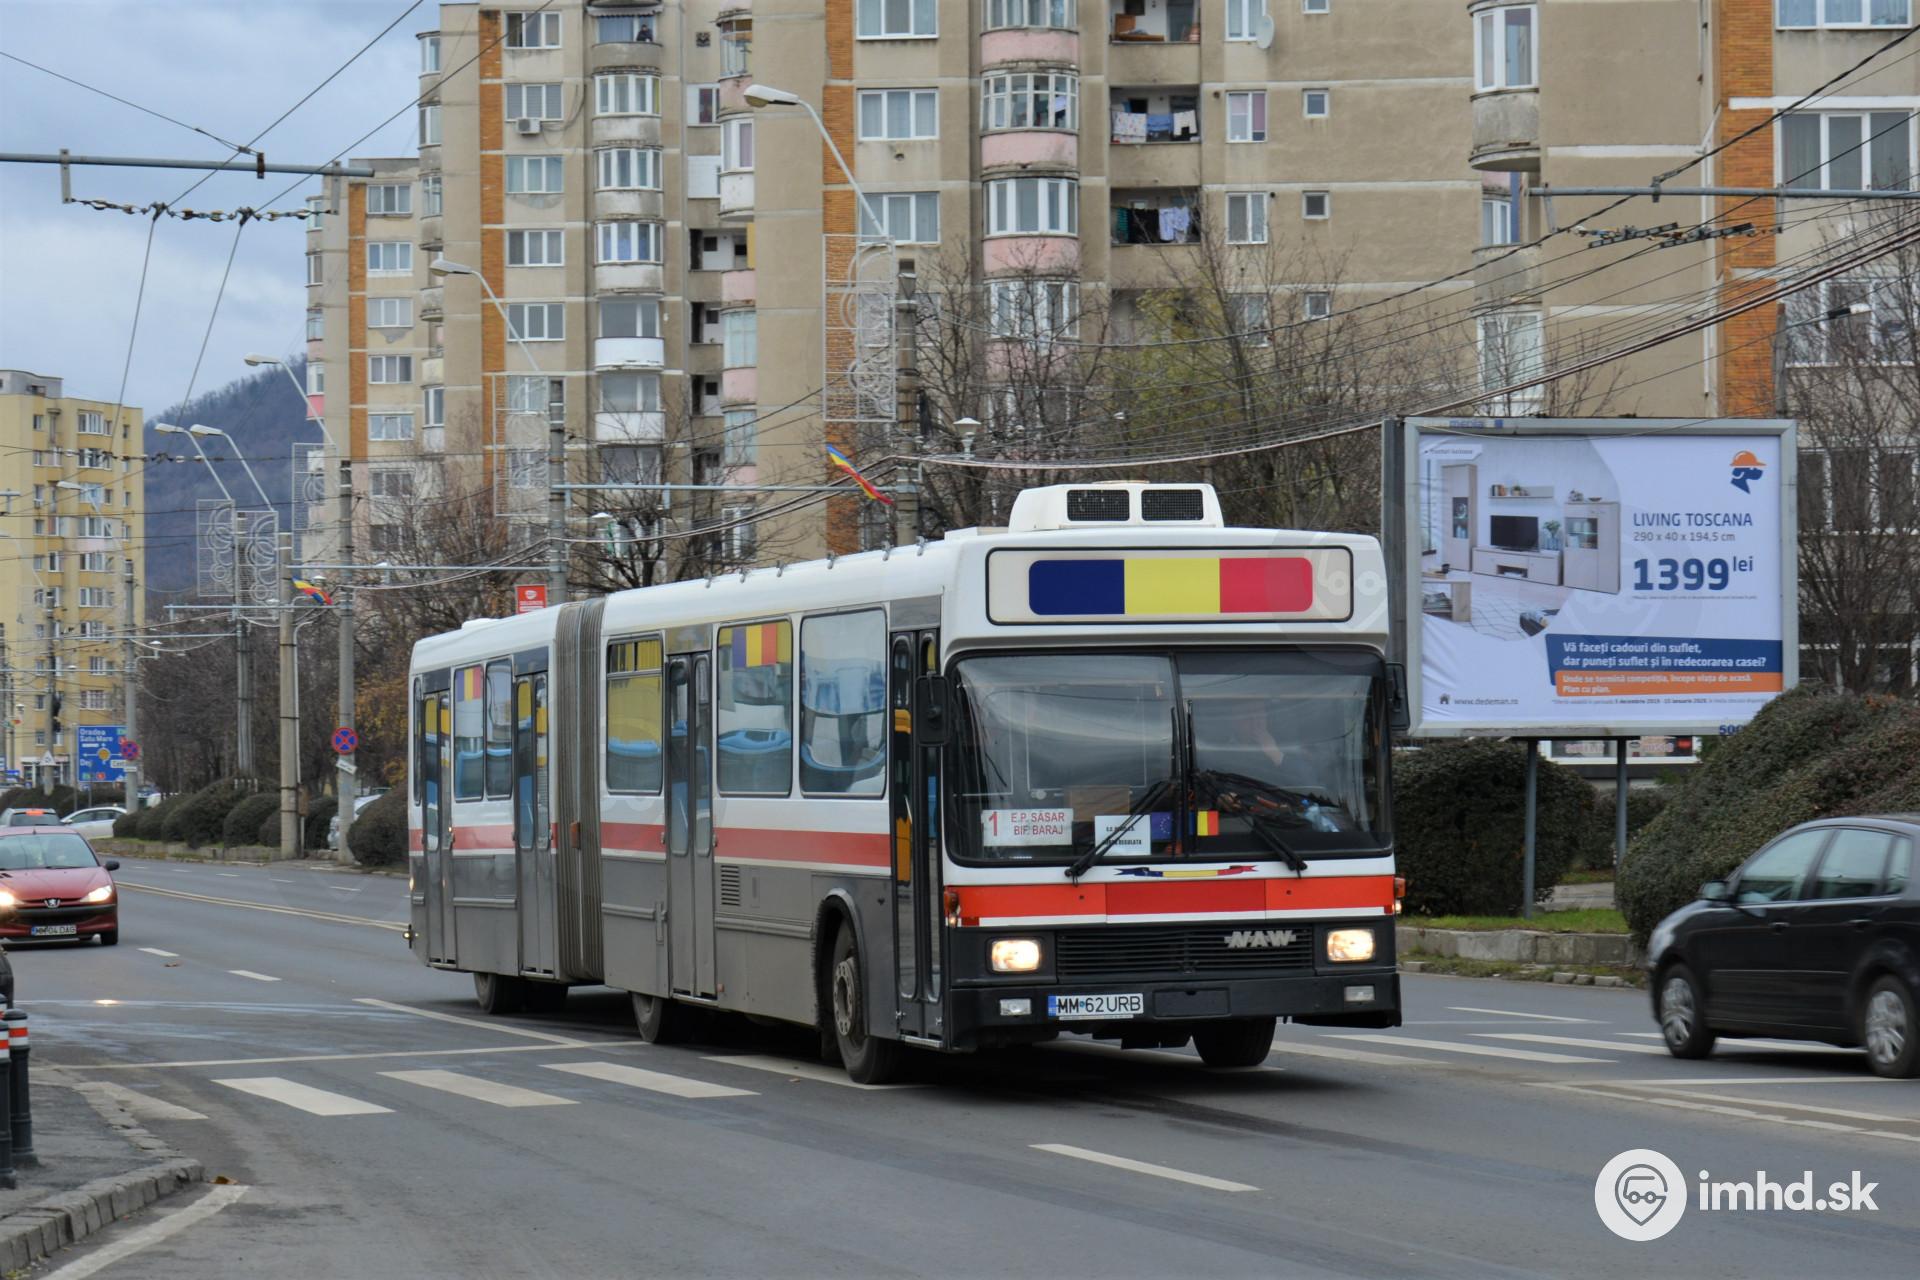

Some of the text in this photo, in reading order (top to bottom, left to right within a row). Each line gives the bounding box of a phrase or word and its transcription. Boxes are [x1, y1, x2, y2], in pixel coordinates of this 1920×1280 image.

[1633, 513, 1753, 526] LIVING TOSCANA
[1633, 531, 1654, 541] 290
[1664, 531, 1679, 541] 40
[1720, 533, 1736, 542] cm
[1633, 556, 1754, 591] 1399 lei
[1563, 642, 1577, 652] Vă
[1610, 642, 1649, 653] cadouri
[1650, 643, 1667, 653] din
[1668, 643, 1702, 654] suflet,
[1562, 656, 1580, 666] dar
[1618, 656, 1649, 667] suflet
[1673, 657, 1734, 667] redecorarea
[1735, 657, 1767, 667] casei?
[988, 811, 999, 837] 1
[1032, 825, 1064, 836] BARAJ
[1057, 998, 1080, 1014] MM
